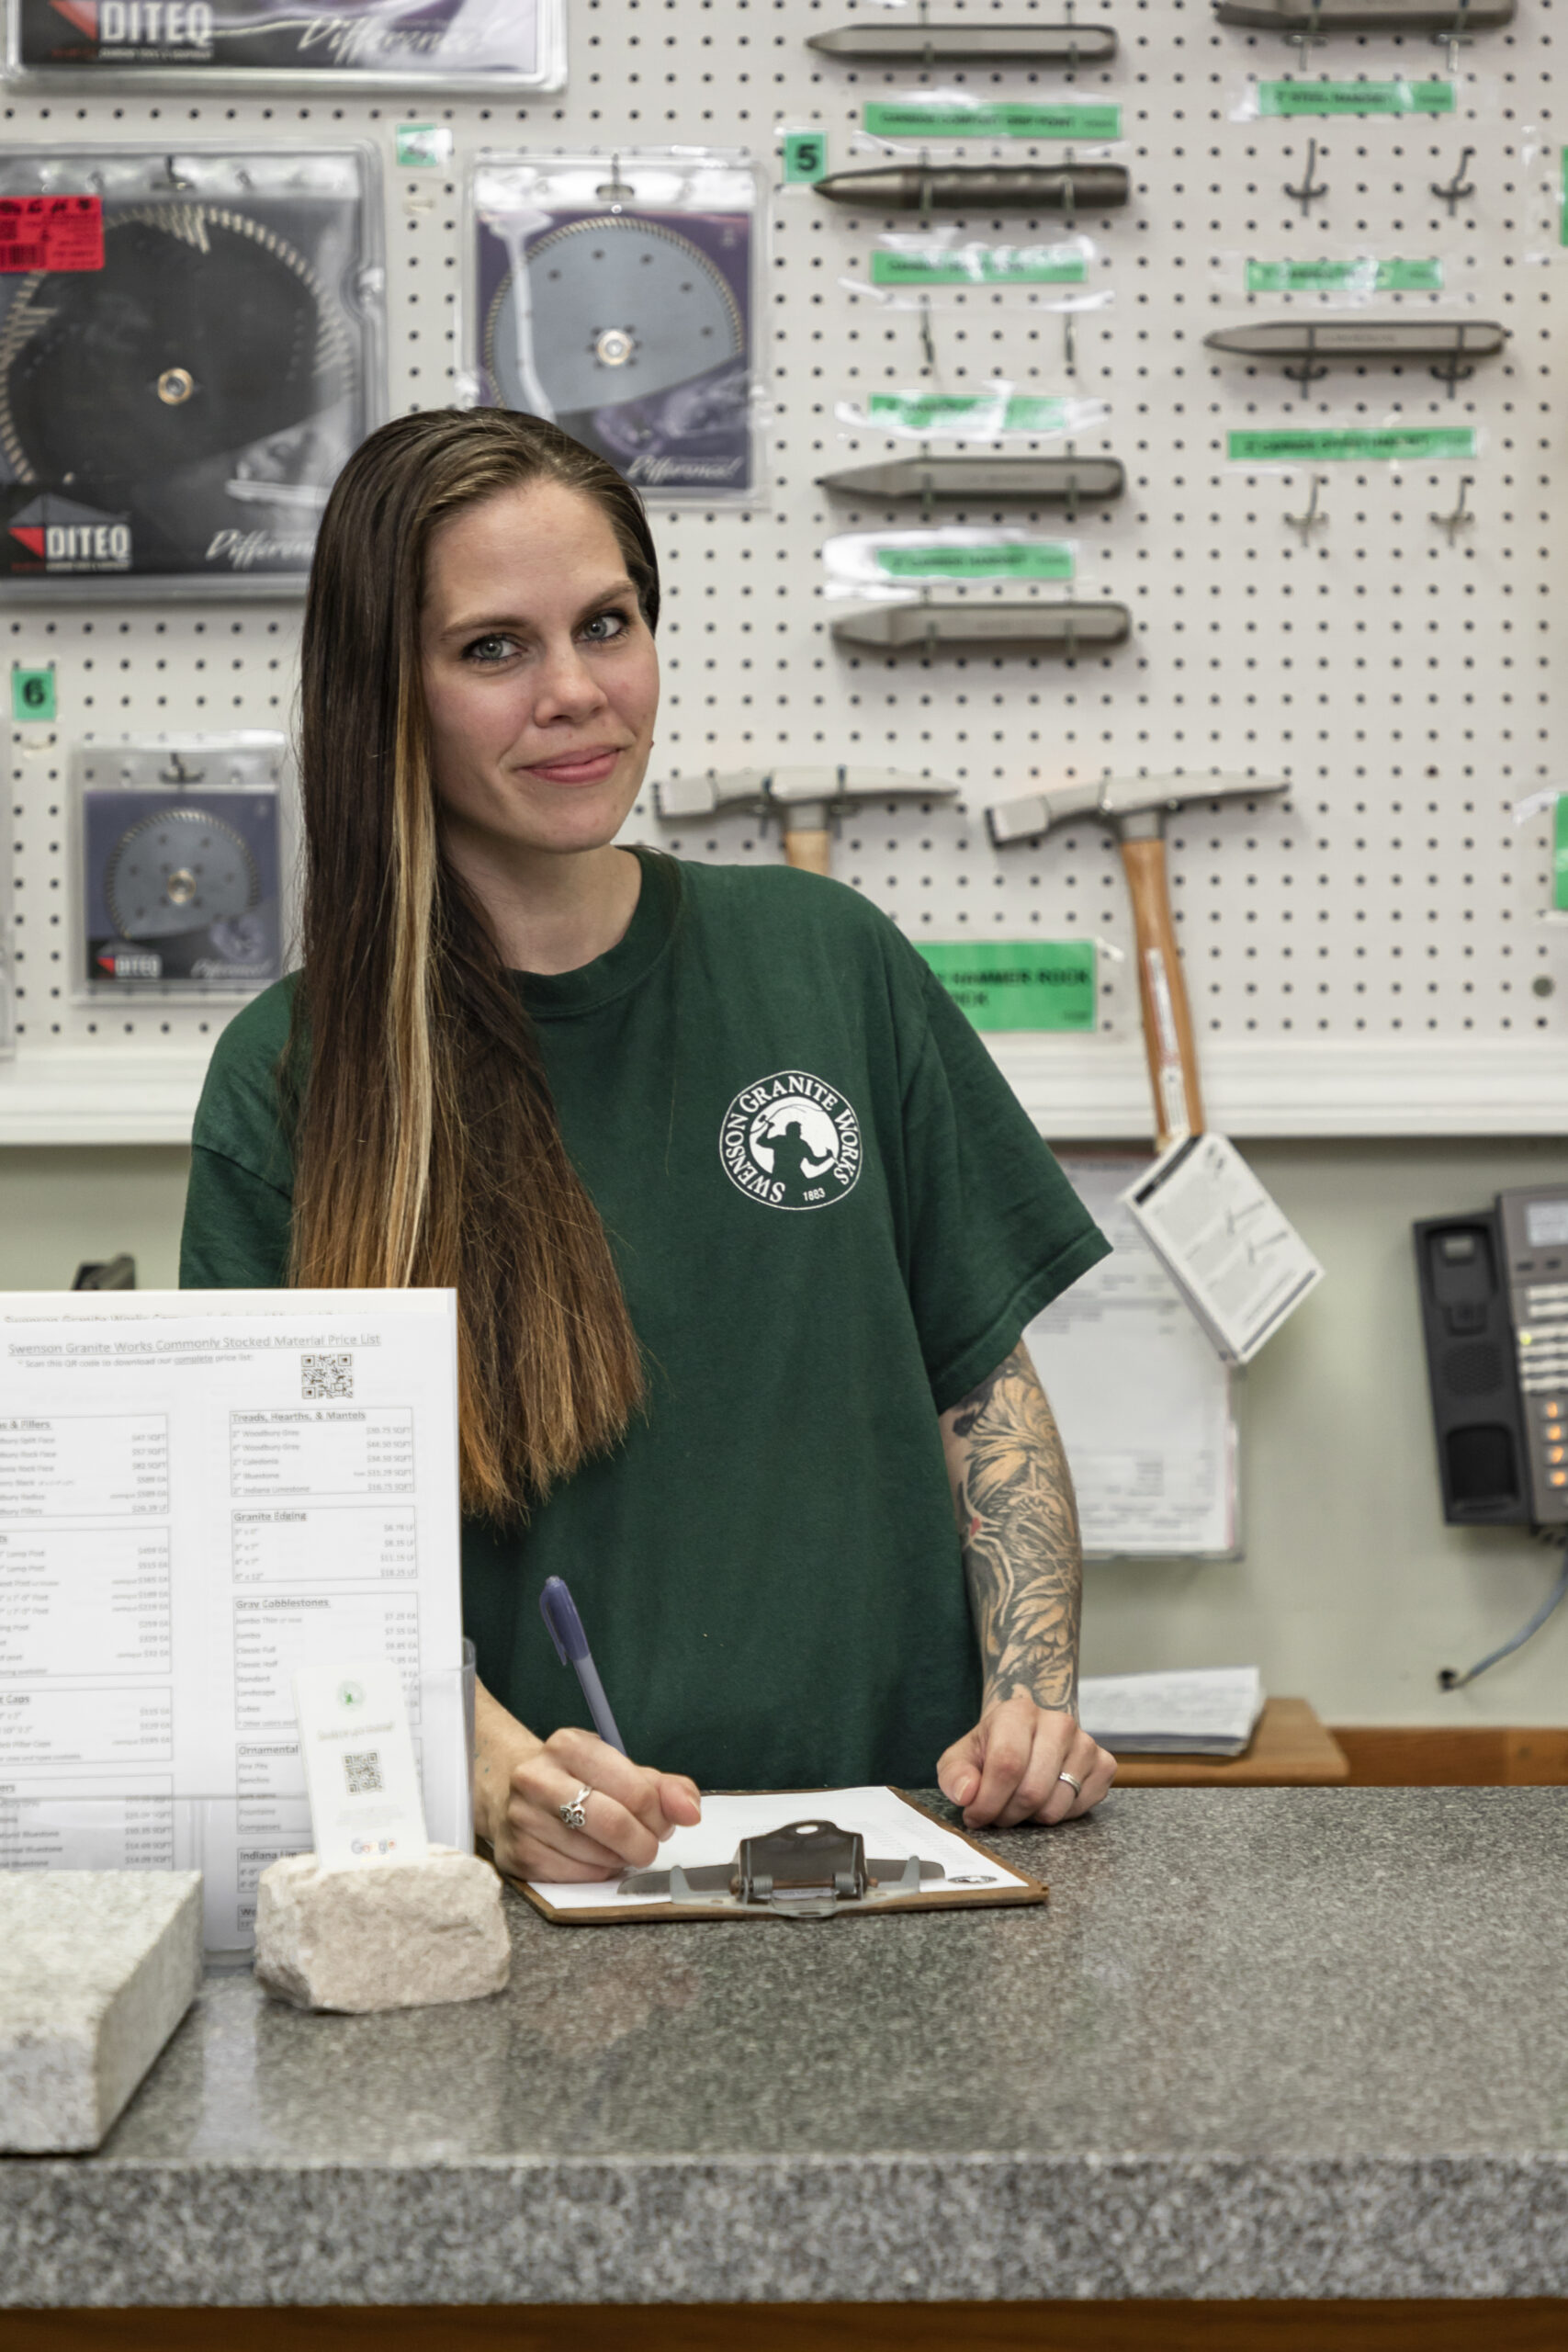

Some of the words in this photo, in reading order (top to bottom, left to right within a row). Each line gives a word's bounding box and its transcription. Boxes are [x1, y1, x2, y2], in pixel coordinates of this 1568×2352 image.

[99, 2, 213, 47] DITEQ
[796, 144, 818, 172] 5
[46, 524, 131, 562] DITEQ
[23, 677, 46, 708] 6
[739, 1075, 839, 1114] GRANITE
[834, 1109, 859, 1185] WORKS
[725, 1113, 785, 1204] SWENSON
[803, 1188, 826, 1201] 1883
[8, 1343, 62, 1354] Swenson
[66, 1342, 110, 1353] Granite
[114, 1340, 152, 1352] Works
[156, 1338, 220, 1352] Commonly
[223, 1336, 270, 1348] Stocked
[275, 1335, 323, 1346] Material
[328, 1335, 356, 1345] Price
[361, 1334, 381, 1344] List
[113, 1357, 154, 1366] download
[174, 1355, 213, 1365] complete
[216, 1354, 236, 1363] price
[232, 1413, 268, 1423] Treads,
[271, 1412, 312, 1422] Hearths,
[315, 1411, 324, 1420] &
[326, 1410, 366, 1420] Mantels
[21, 1419, 51, 1430] Fillers
[234, 1511, 271, 1522] Granite
[274, 1511, 308, 1521] Edging
[236, 1600, 259, 1610] Gray
[262, 1599, 330, 1609] Cobblestones
[6, 1695, 30, 1705] Caps
[239, 1745, 299, 1755] Ornamental
[240, 1851, 277, 1860] Indiana
